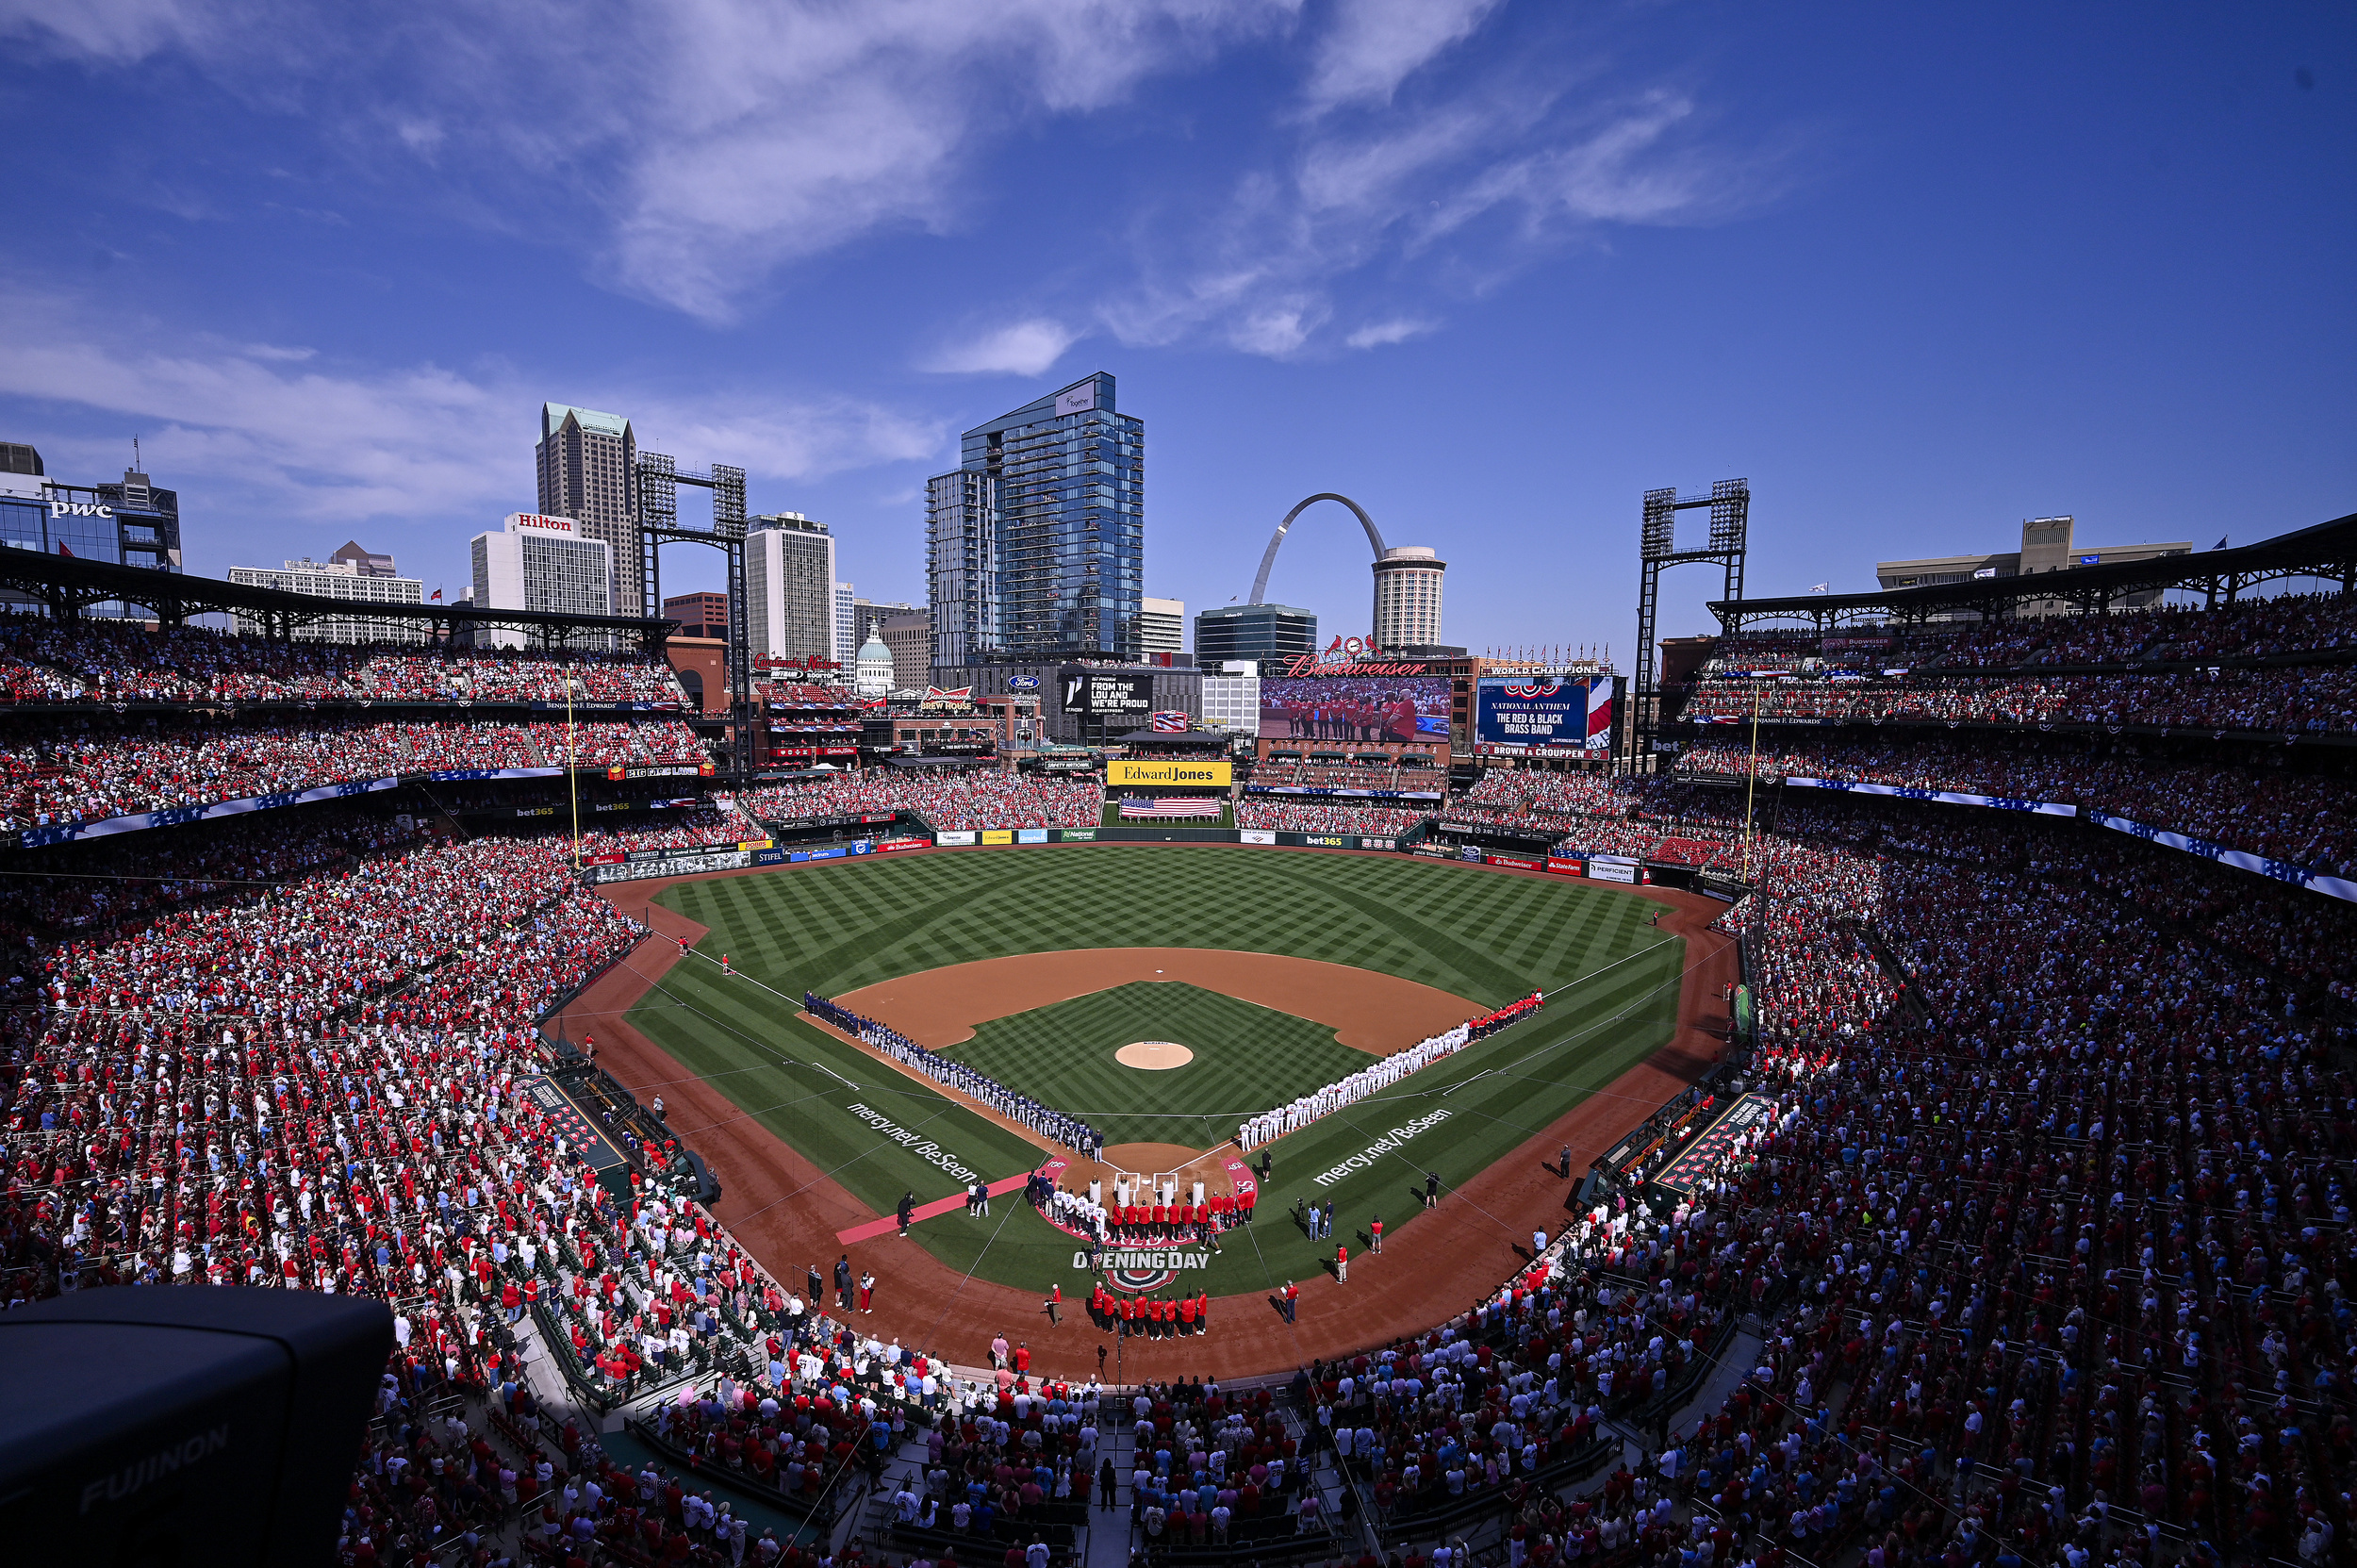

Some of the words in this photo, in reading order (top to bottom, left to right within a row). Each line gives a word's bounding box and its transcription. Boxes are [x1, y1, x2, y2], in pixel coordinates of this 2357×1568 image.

[1070, 398, 1089, 407] Together
[49, 502, 113, 519] pwc
[519, 514, 572, 532] Hilton
[754, 652, 802, 670] Cardinals
[803, 654, 842, 671] Nation
[1283, 653, 1427, 678] Budweiser
[1492, 667, 1529, 675] WORLD
[1532, 666, 1600, 674] CHAMPIONS
[1015, 677, 1034, 687] Ford
[1091, 683, 1116, 691] FROM
[1117, 683, 1134, 691] THE
[927, 691, 970, 701] Budweiser
[1091, 691, 1110, 700] LOU
[1111, 691, 1129, 700] AND
[1091, 700, 1119, 708] WE'RE
[1120, 700, 1148, 708] PROUD
[1529, 702, 1571, 711] ANTHEM
[1496, 713, 1511, 723] THE
[1511, 713, 1527, 723] RED
[1528, 714, 1536, 723] &
[1537, 714, 1563, 724] BLACK
[1504, 724, 1529, 734] BRASS
[1531, 724, 1553, 735] BAND
[1493, 747, 1525, 755] BROWN
[1535, 749, 1585, 758] CROUPPEN
[626, 768, 646, 778] BIG
[648, 767, 671, 777] MAC
[672, 767, 699, 775] LAND
[1124, 766, 1171, 779] Edward
[1173, 767, 1213, 782] Jones
[517, 807, 554, 817] bet365
[595, 803, 630, 812] bet365
[1307, 835, 1343, 846] bet365
[759, 852, 783, 862] STIFEL
[1503, 859, 1533, 868] Budweiser
[1597, 867, 1633, 876] PERFICIENT
[847, 1102, 978, 1183] mercy.net/BeSeen
[1312, 1108, 1453, 1186] mercy.net/BeSeen
[1168, 1251, 1210, 1269] DAY
[1215, 1459, 1225, 1467] 22
[79, 1423, 230, 1516] FUJINON
[604, 1517, 615, 1526] 50
[343, 1557, 354, 1566] 25
